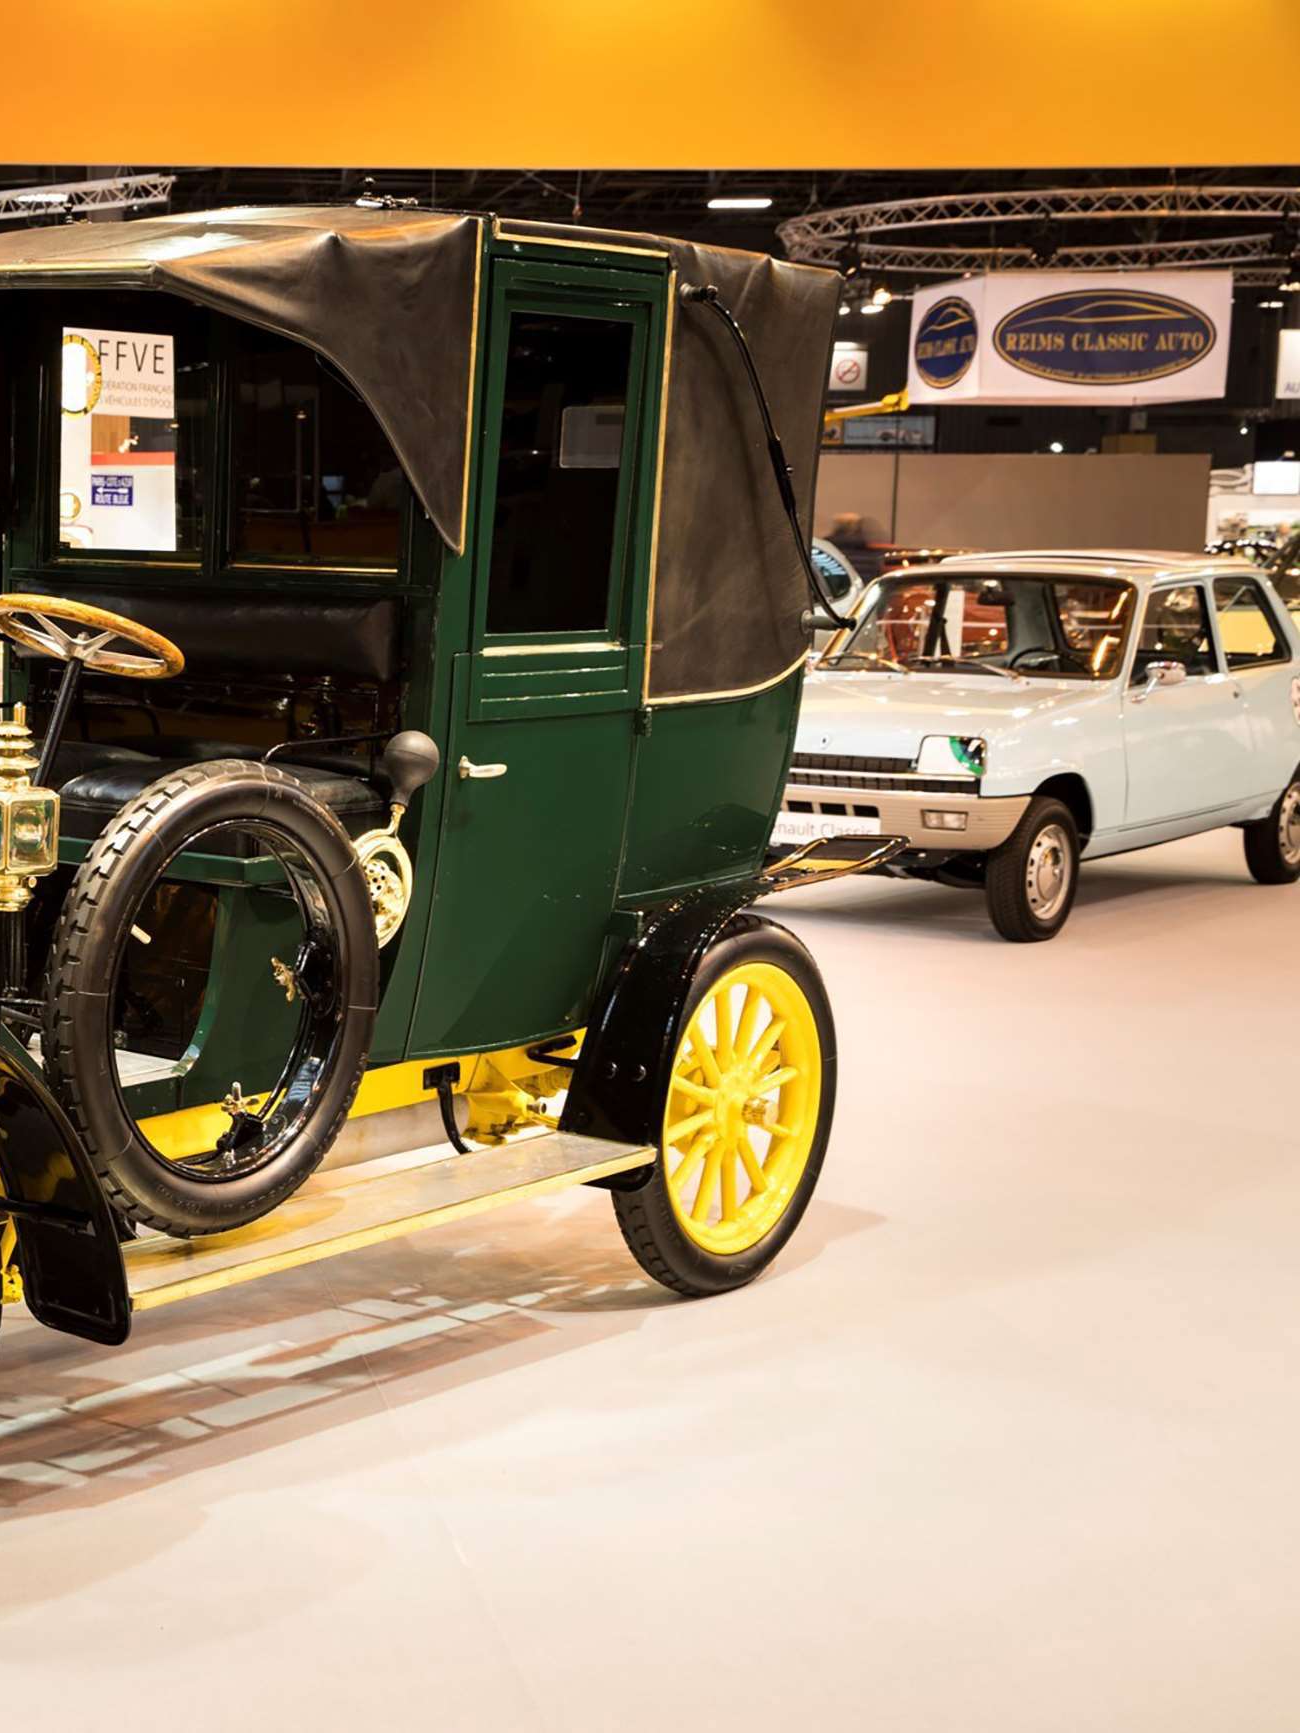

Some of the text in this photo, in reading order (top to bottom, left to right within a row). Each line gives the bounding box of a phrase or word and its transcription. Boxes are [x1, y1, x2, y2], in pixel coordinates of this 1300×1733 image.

[1005, 331, 1205, 352] REIMS CLASSIC AUTO
[98, 339, 165, 375] FFVE
